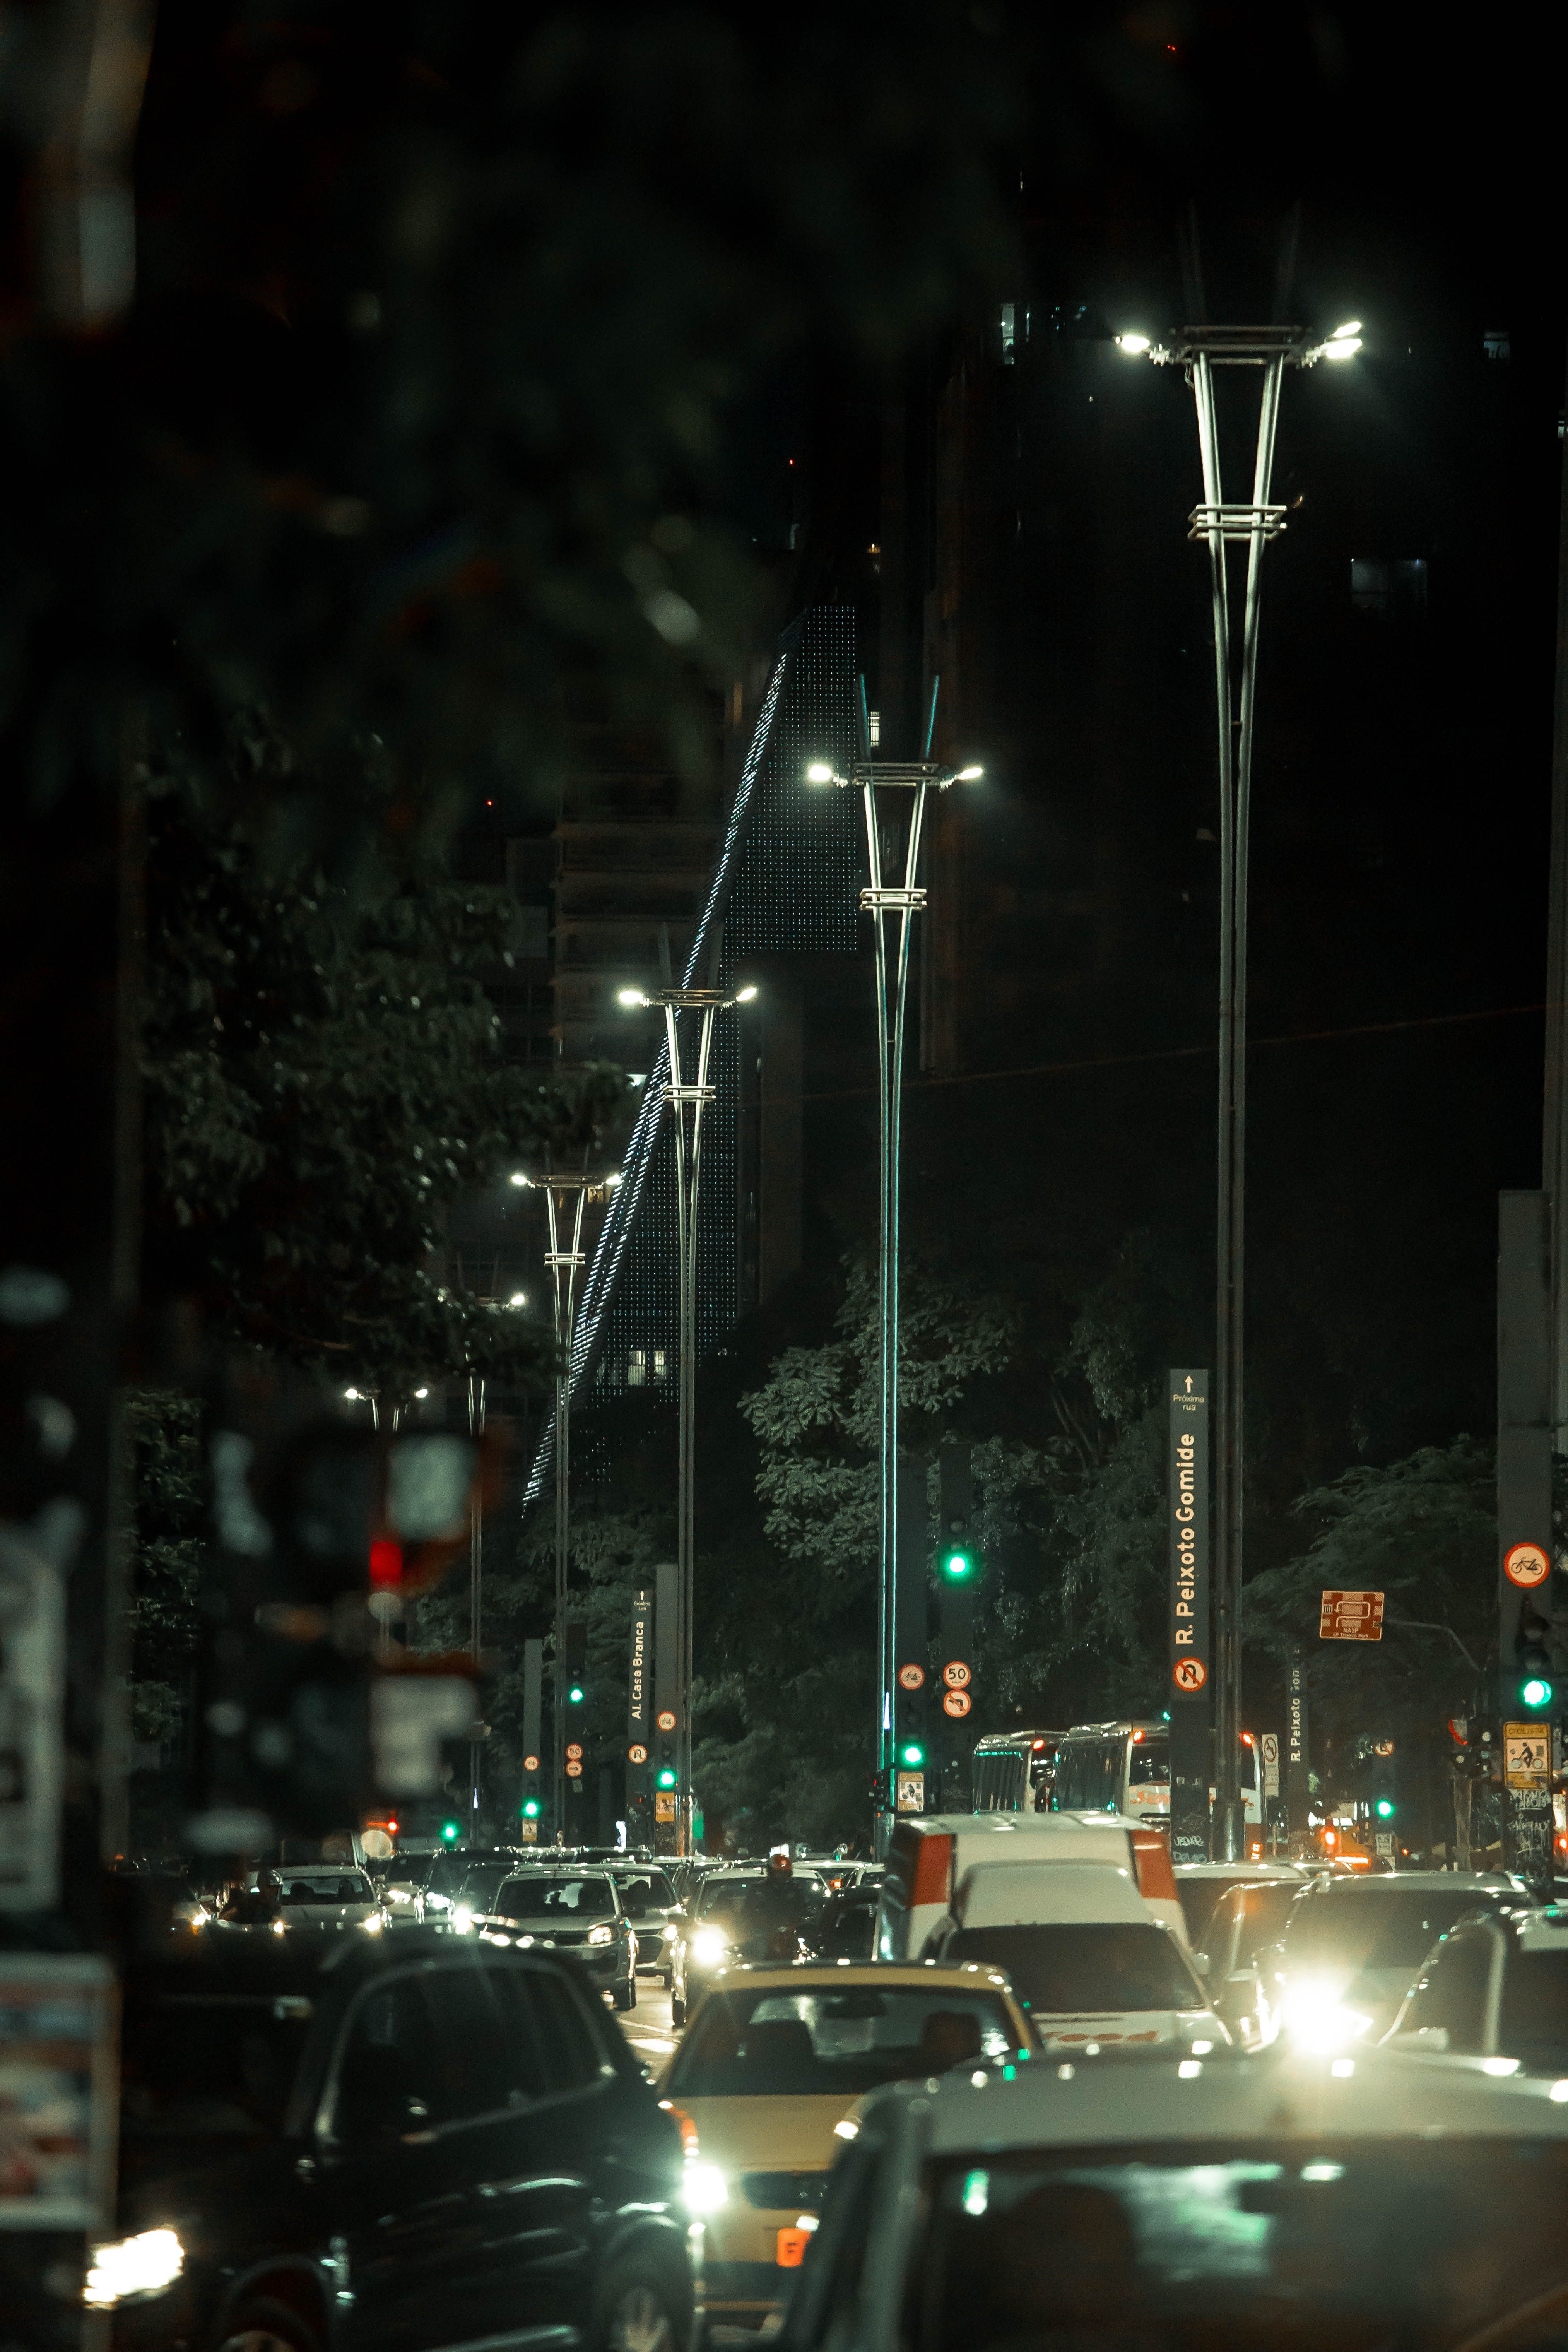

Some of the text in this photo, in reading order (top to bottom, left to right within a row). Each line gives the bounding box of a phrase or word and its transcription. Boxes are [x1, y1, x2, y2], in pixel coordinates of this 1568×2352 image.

[1176, 1434, 1195, 1644] R. Peixoto Gomide
[633, 1622, 644, 1666] Branca
[632, 1669, 641, 1700] Casa
[949, 1668, 966, 1679] 50
[1291, 1698, 1300, 1746] Peixoto
